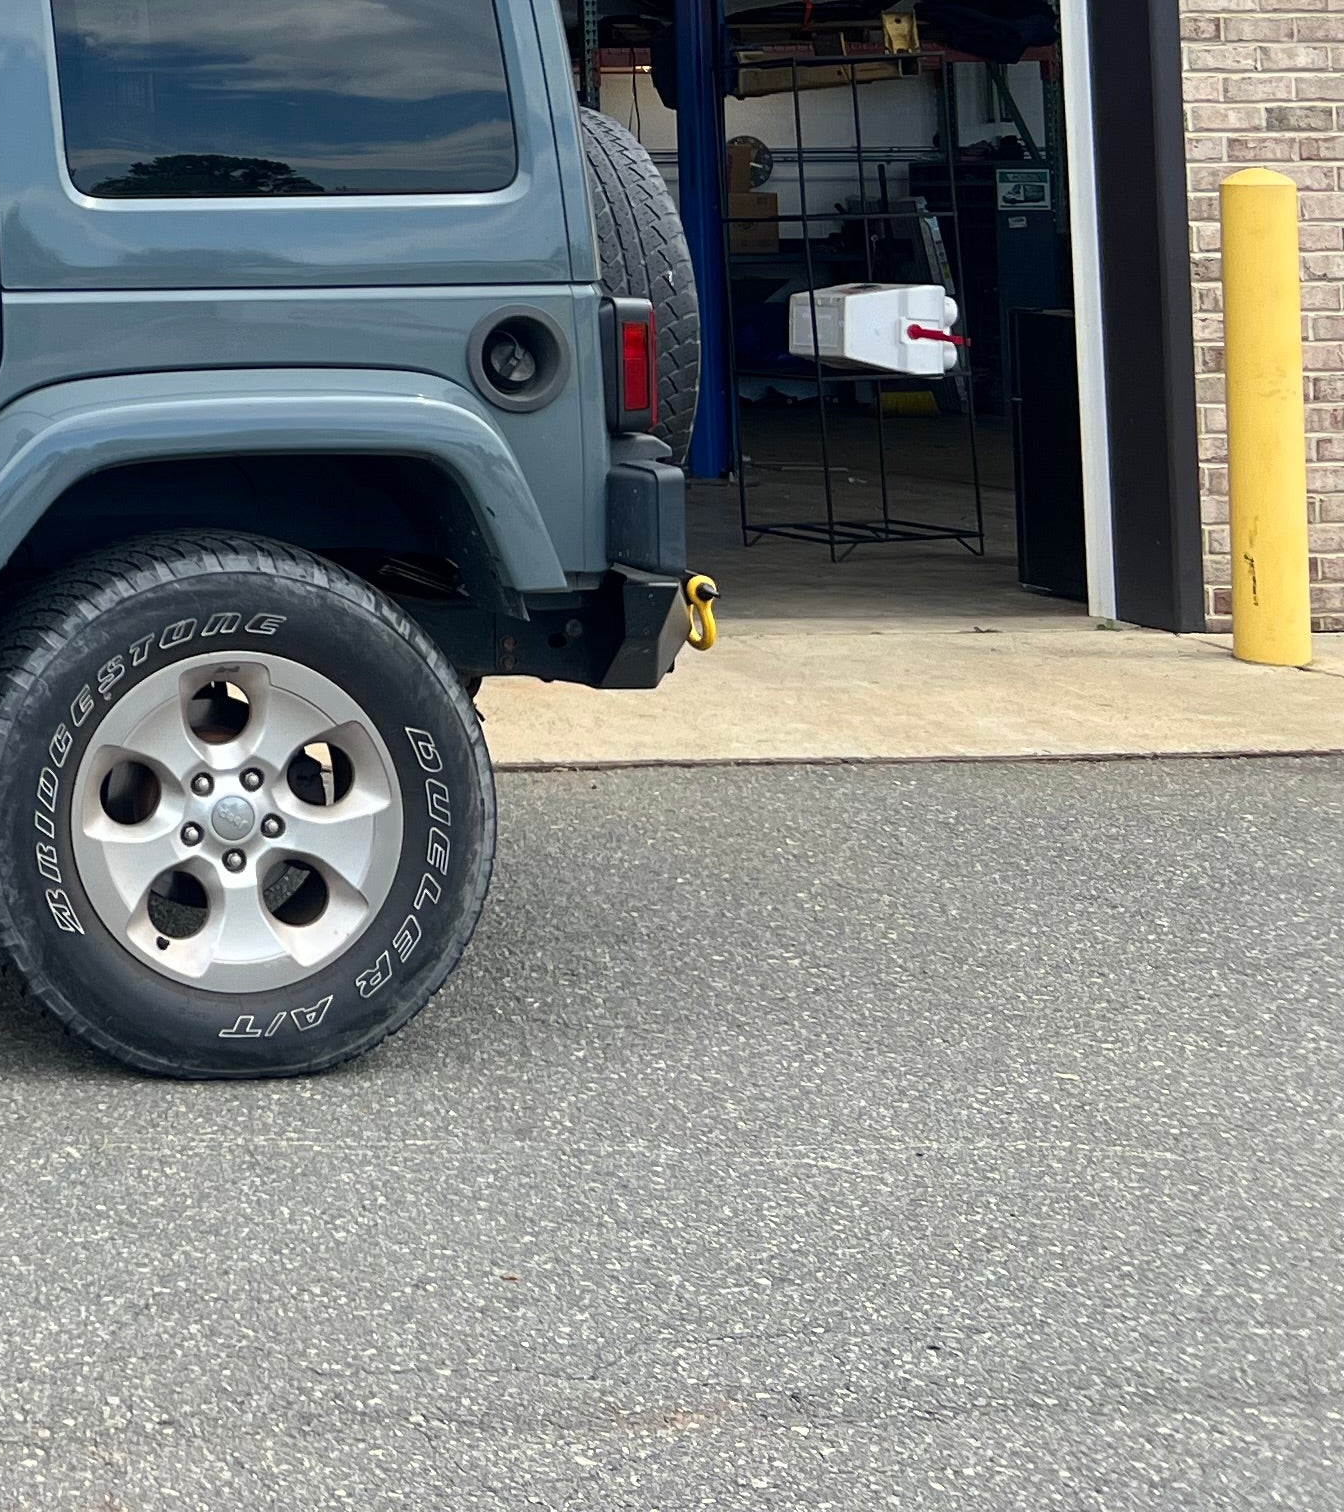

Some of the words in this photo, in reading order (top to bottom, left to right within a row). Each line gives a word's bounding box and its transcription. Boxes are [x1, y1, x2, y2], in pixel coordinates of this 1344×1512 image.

[34, 610, 287, 936] BRIDGESTONE
[354, 726, 453, 999] DUELER
[218, 993, 334, 1038] A/T
